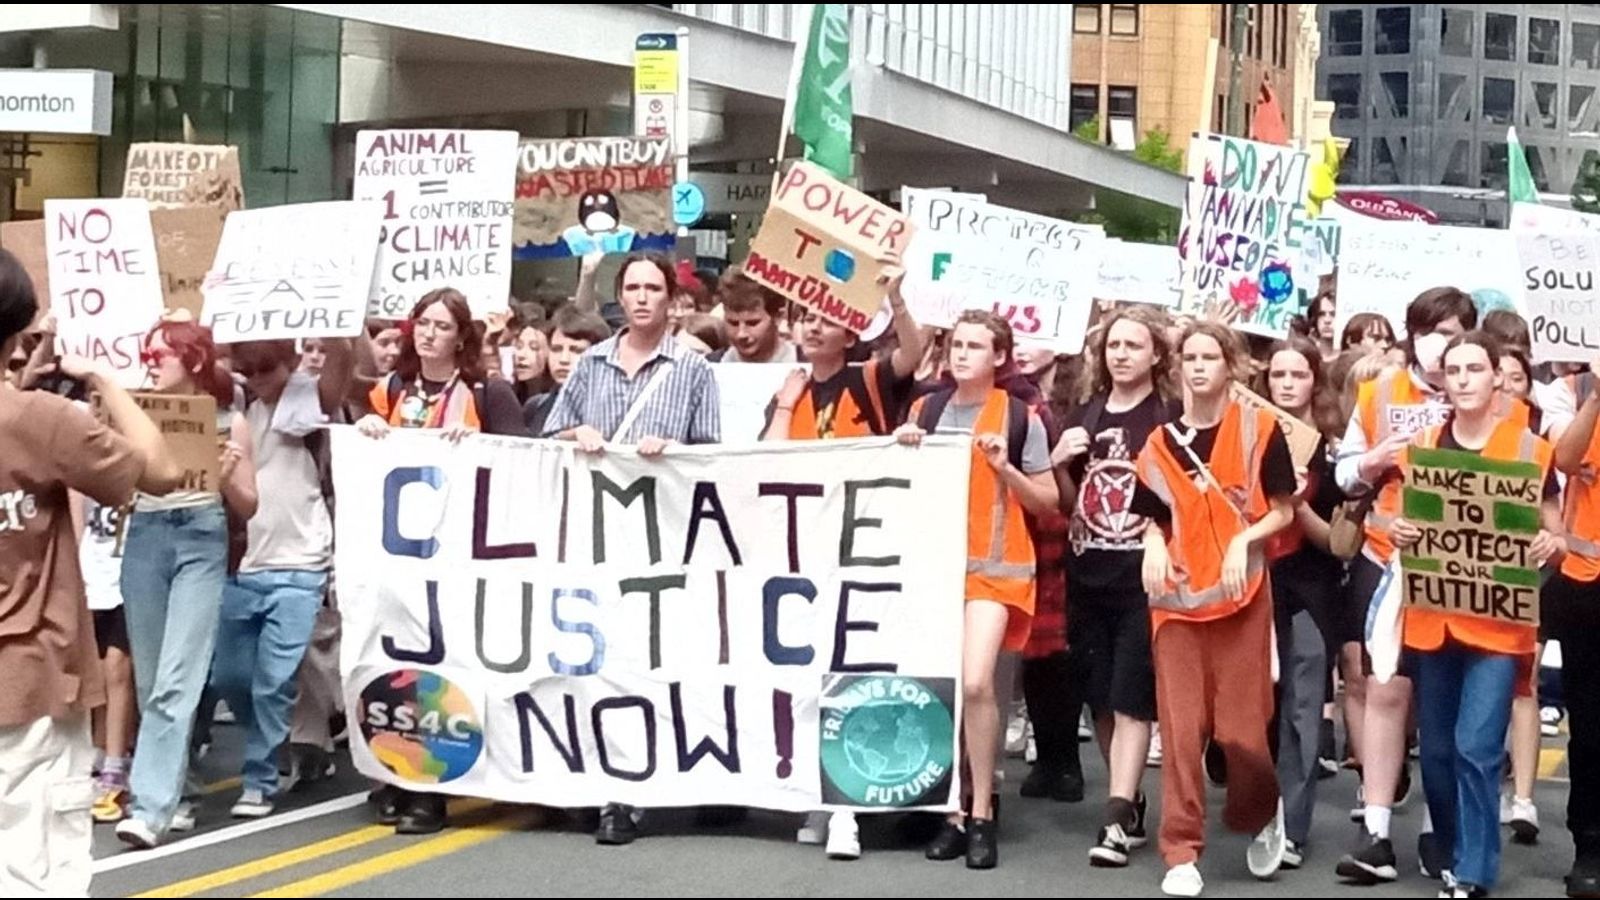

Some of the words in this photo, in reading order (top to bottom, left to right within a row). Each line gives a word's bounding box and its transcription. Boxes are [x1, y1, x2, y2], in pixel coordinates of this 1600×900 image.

[367, 133, 472, 157] ANIMAL
[358, 156, 477, 176] AGRICULTURE
[727, 184, 772, 201] HAR
[778, 168, 905, 249] POWER
[59, 208, 112, 244] NO
[391, 223, 501, 253] CLIMATE
[56, 249, 145, 275] TIME
[392, 252, 500, 283] CHANGE
[61, 288, 105, 318] TO
[211, 306, 356, 334] FUTURE
[1412, 467, 1476, 496] MAKE
[1484, 476, 1539, 504] LAWS
[382, 466, 911, 573] CLIMATE
[1448, 500, 1484, 523] TO
[1409, 528, 1532, 566] PROTECT
[1446, 561, 1492, 580] OUR
[1407, 574, 1533, 621] FUTURE
[381, 570, 902, 676] JUSTICE
[889, 680, 931, 709] FOR
[367, 701, 471, 739] SS4C
[514, 682, 794, 781] NOW!
[865, 760, 945, 803] FUTURE
